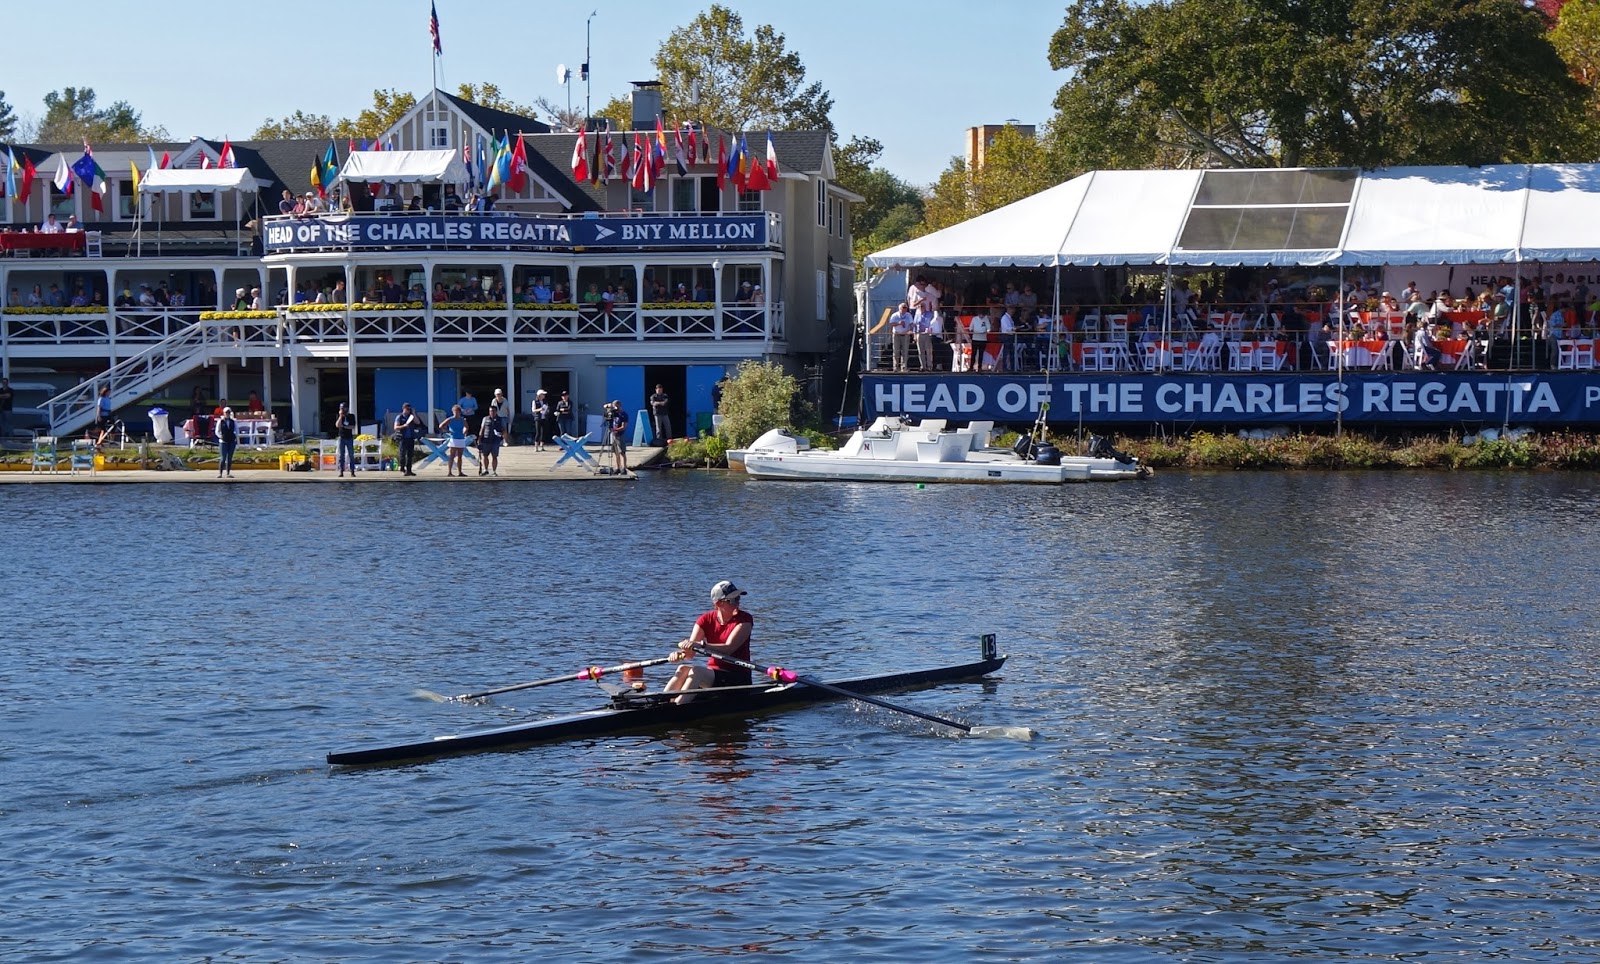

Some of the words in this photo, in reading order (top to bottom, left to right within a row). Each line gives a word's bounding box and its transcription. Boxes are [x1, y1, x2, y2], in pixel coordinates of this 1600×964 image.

[268, 226, 293, 244] HEAD
[297, 225, 321, 242] OF
[324, 224, 360, 242] THE
[367, 222, 473, 241] CHARLES
[480, 223, 571, 242] REGATTA
[621, 224, 664, 240] BNY
[669, 223, 756, 239] MELLON
[875, 383, 985, 413] HEAD
[997, 383, 1053, 413] OF
[1063, 383, 1143, 413] THE
[1155, 382, 1350, 413] CHARLES
[1362, 382, 1561, 413] REGATTA
[985, 635, 996, 656] 13
